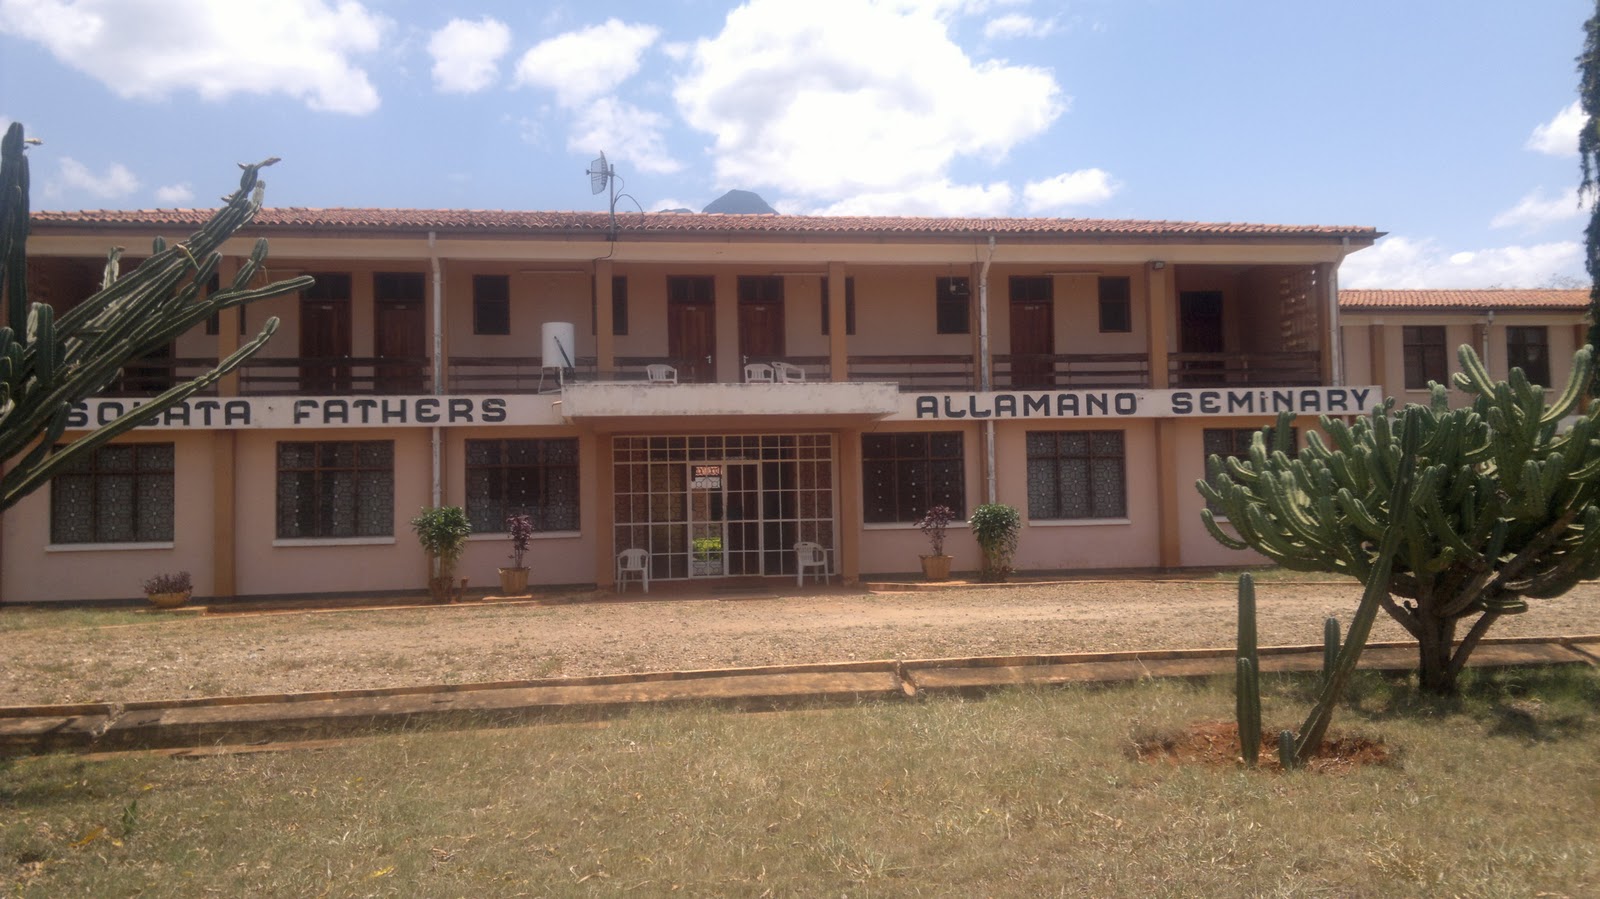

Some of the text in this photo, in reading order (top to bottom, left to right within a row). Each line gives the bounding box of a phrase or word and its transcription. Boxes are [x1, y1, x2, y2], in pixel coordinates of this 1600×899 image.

[293, 398, 507, 425] FATHERS
[916, 388, 1370, 419] ALLAMANO SEMINARY
